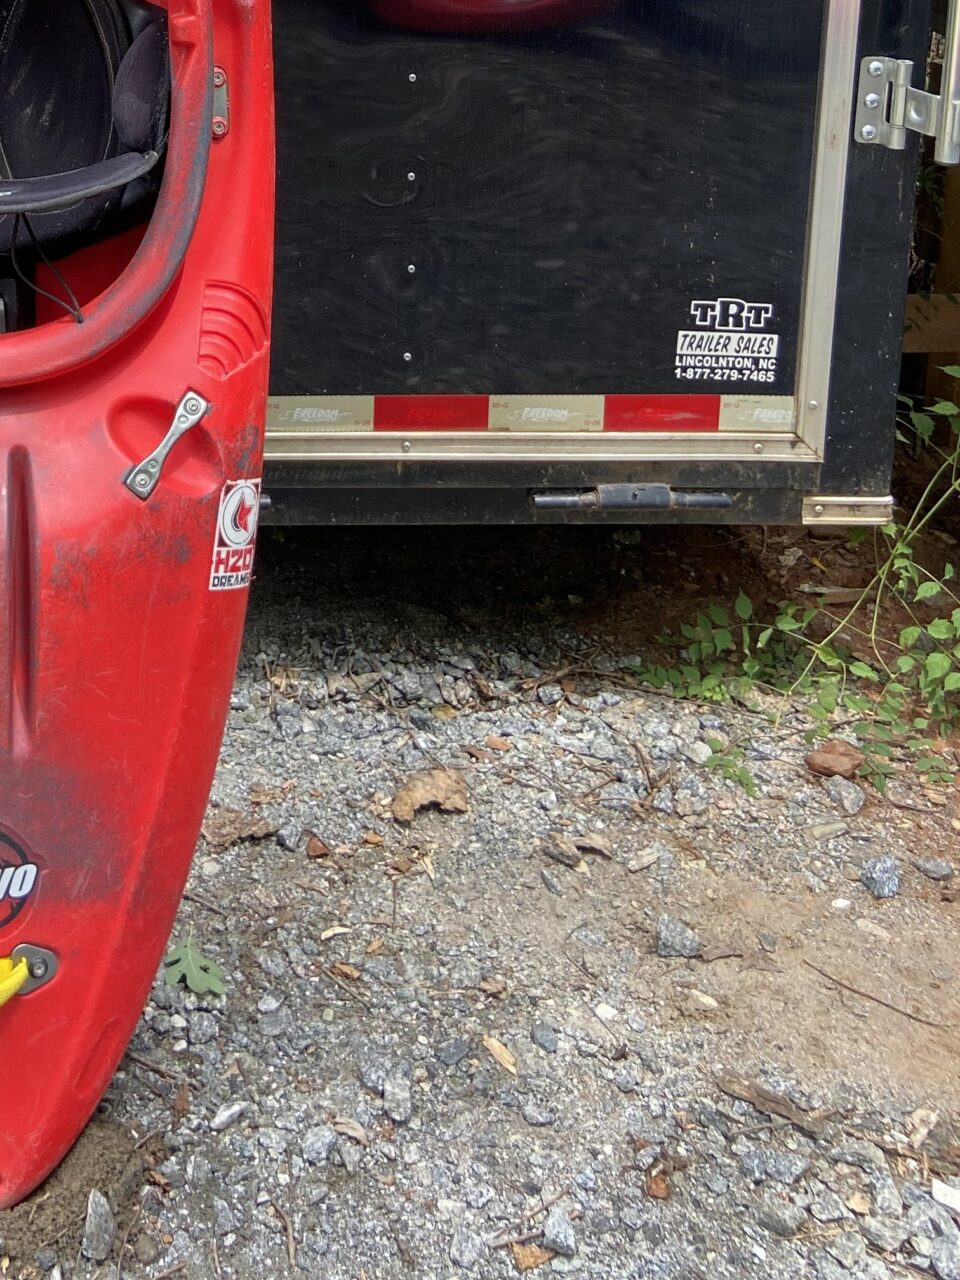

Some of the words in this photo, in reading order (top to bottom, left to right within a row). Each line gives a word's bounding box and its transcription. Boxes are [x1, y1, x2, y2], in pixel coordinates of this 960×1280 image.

[690, 298, 772, 330] TRT
[680, 333, 731, 353] TRAILER
[734, 335, 774, 355] SALES
[675, 355, 755, 370] LINCOLNTON,
[758, 358, 777, 369] NC
[674, 368, 775, 382] 1-877-279-7465
